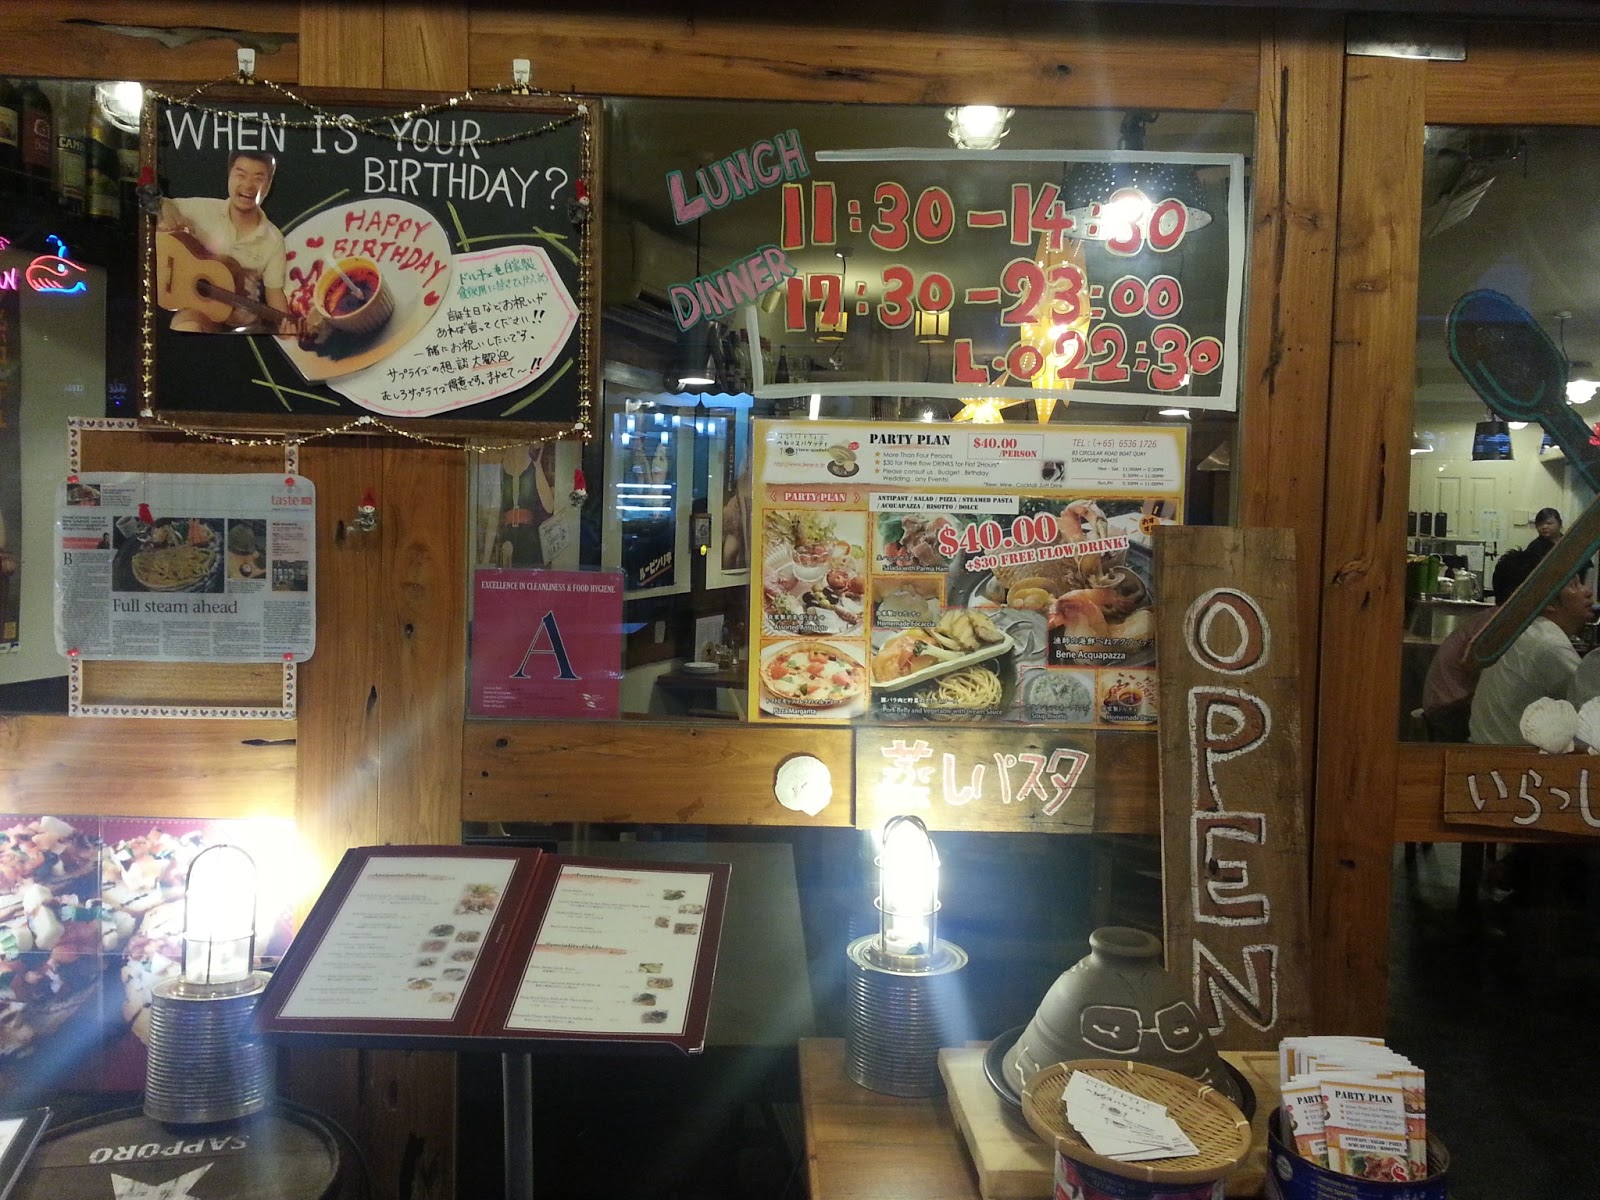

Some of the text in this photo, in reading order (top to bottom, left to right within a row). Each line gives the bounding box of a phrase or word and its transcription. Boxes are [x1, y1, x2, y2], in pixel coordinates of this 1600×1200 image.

[165, 109, 481, 160] WHEN IS YOUR
[364, 156, 569, 211] BIRTHDAY?
[666, 128, 811, 225] LUNCH
[345, 209, 433, 243] HAPPY
[332, 238, 448, 289] BIRTHDAY
[669, 243, 798, 333] DINNER
[1054, 322, 1223, 392] 22:30
[869, 433, 951, 446] PARTY PLAN
[973, 437, 1018, 450] $40.00
[916, 452, 930, 460] Four
[932, 460, 954, 468] DRINKS
[882, 468, 901, 476] Please
[964, 469, 989, 478] Birthday
[882, 475, 910, 484] Wedding
[271, 494, 300, 506] taste
[784, 492, 847, 502] PARTY PLAN
[877, 494, 909, 502] ANTIPAST
[938, 495, 957, 503] PIZZA
[962, 496, 992, 504] STEAMED
[938, 511, 1059, 559] $40.00
[999, 549, 1037, 568] FREE
[1038, 542, 1076, 563] FLOW
[1077, 535, 1130, 557] DRINK!
[481, 580, 519, 590] EXCELLENCE
[519, 581, 526, 590] IN
[526, 582, 566, 592] CLEANLINESS
[572, 583, 590, 593] FOOD
[590, 584, 616, 594] HYGIENE
[112, 599, 238, 614] Full steam ahead
[508, 609, 582, 681] A
[1055, 650, 1126, 661] Bene Acquapazza
[1183, 587, 1279, 1036] OPEN
[1335, 1090, 1393, 1104] PARTY PLAN
[89, 1134, 250, 1164] SAPPORO
